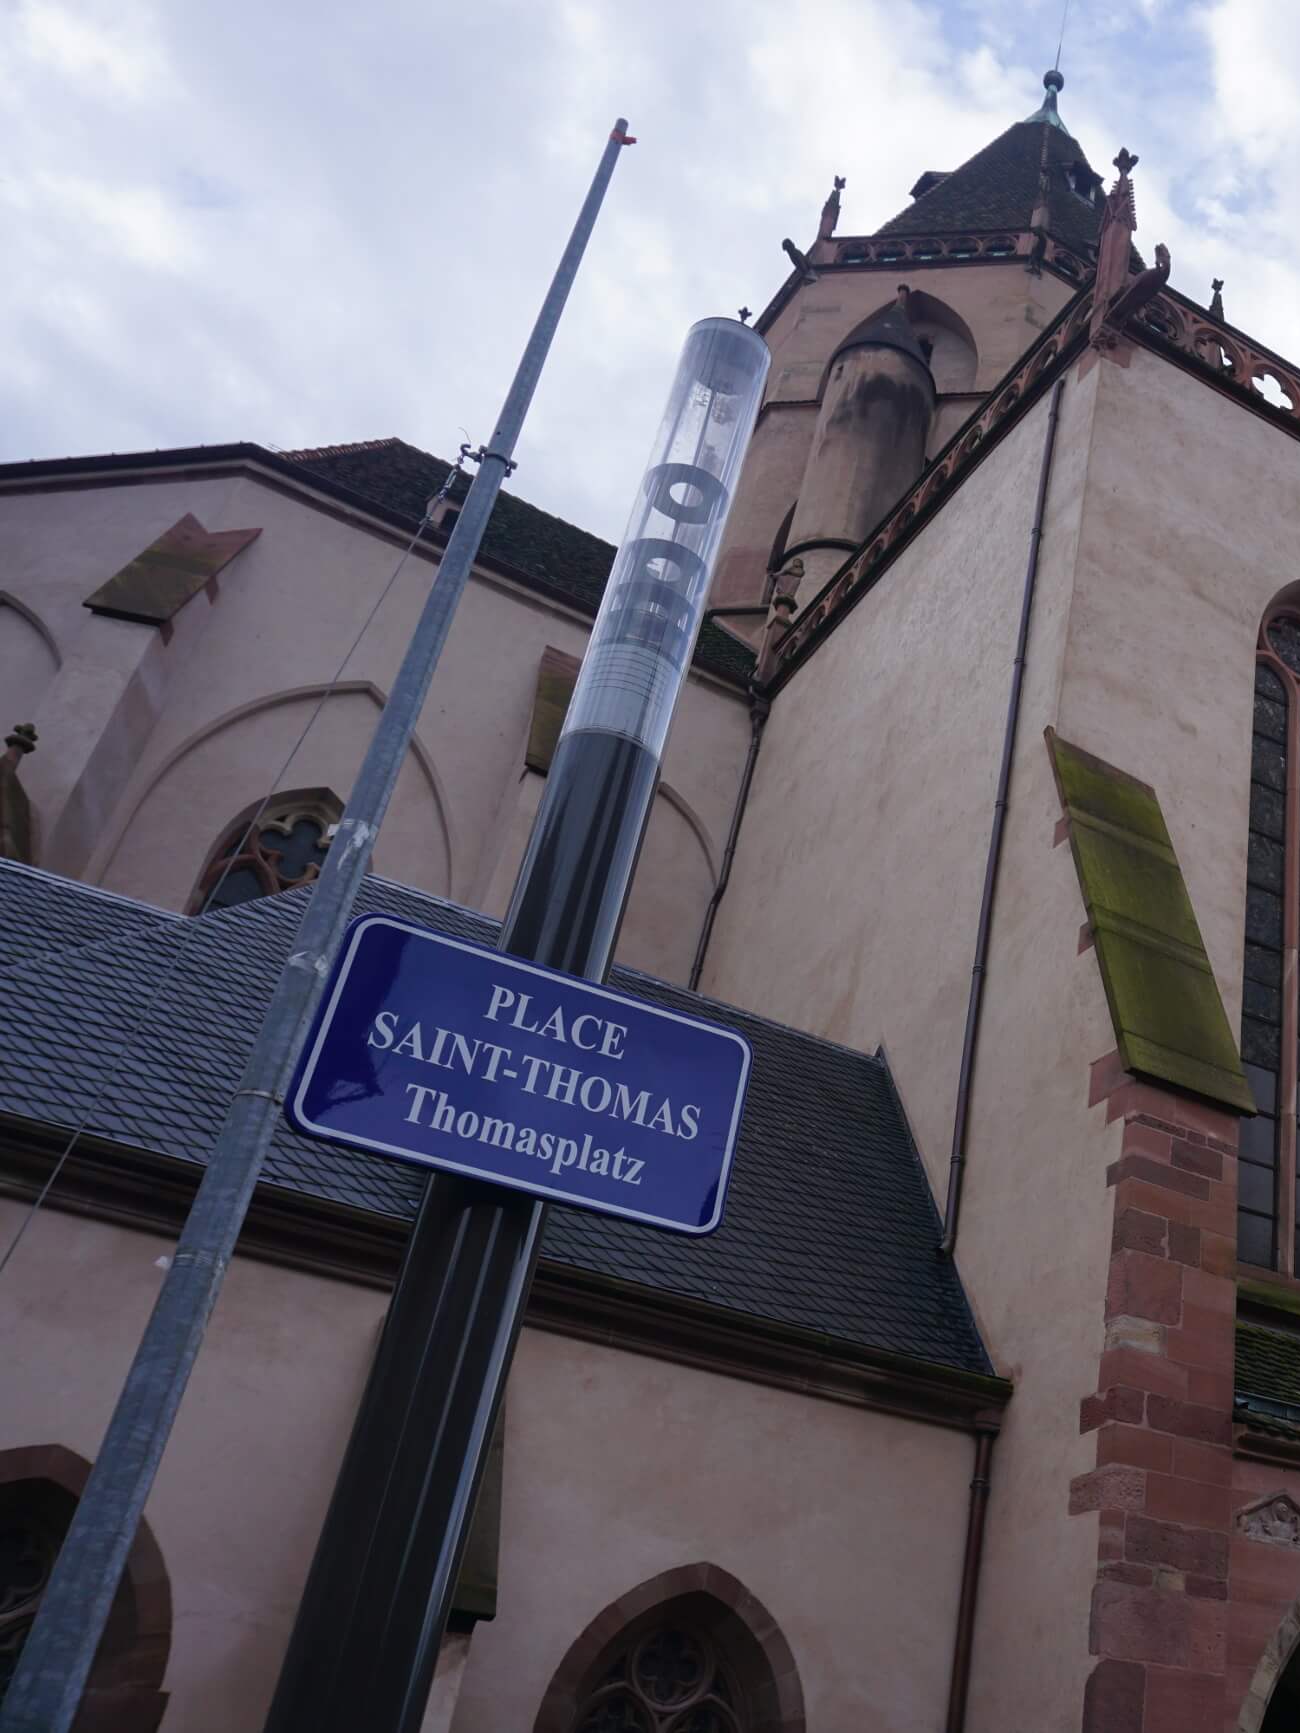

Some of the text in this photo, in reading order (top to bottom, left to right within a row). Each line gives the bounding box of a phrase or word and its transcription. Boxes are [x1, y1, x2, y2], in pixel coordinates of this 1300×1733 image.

[484, 984, 628, 1060] PLACE
[367, 1011, 701, 1140] SAINT-THOMAS
[404, 1083, 647, 1185] Thomasplatz
